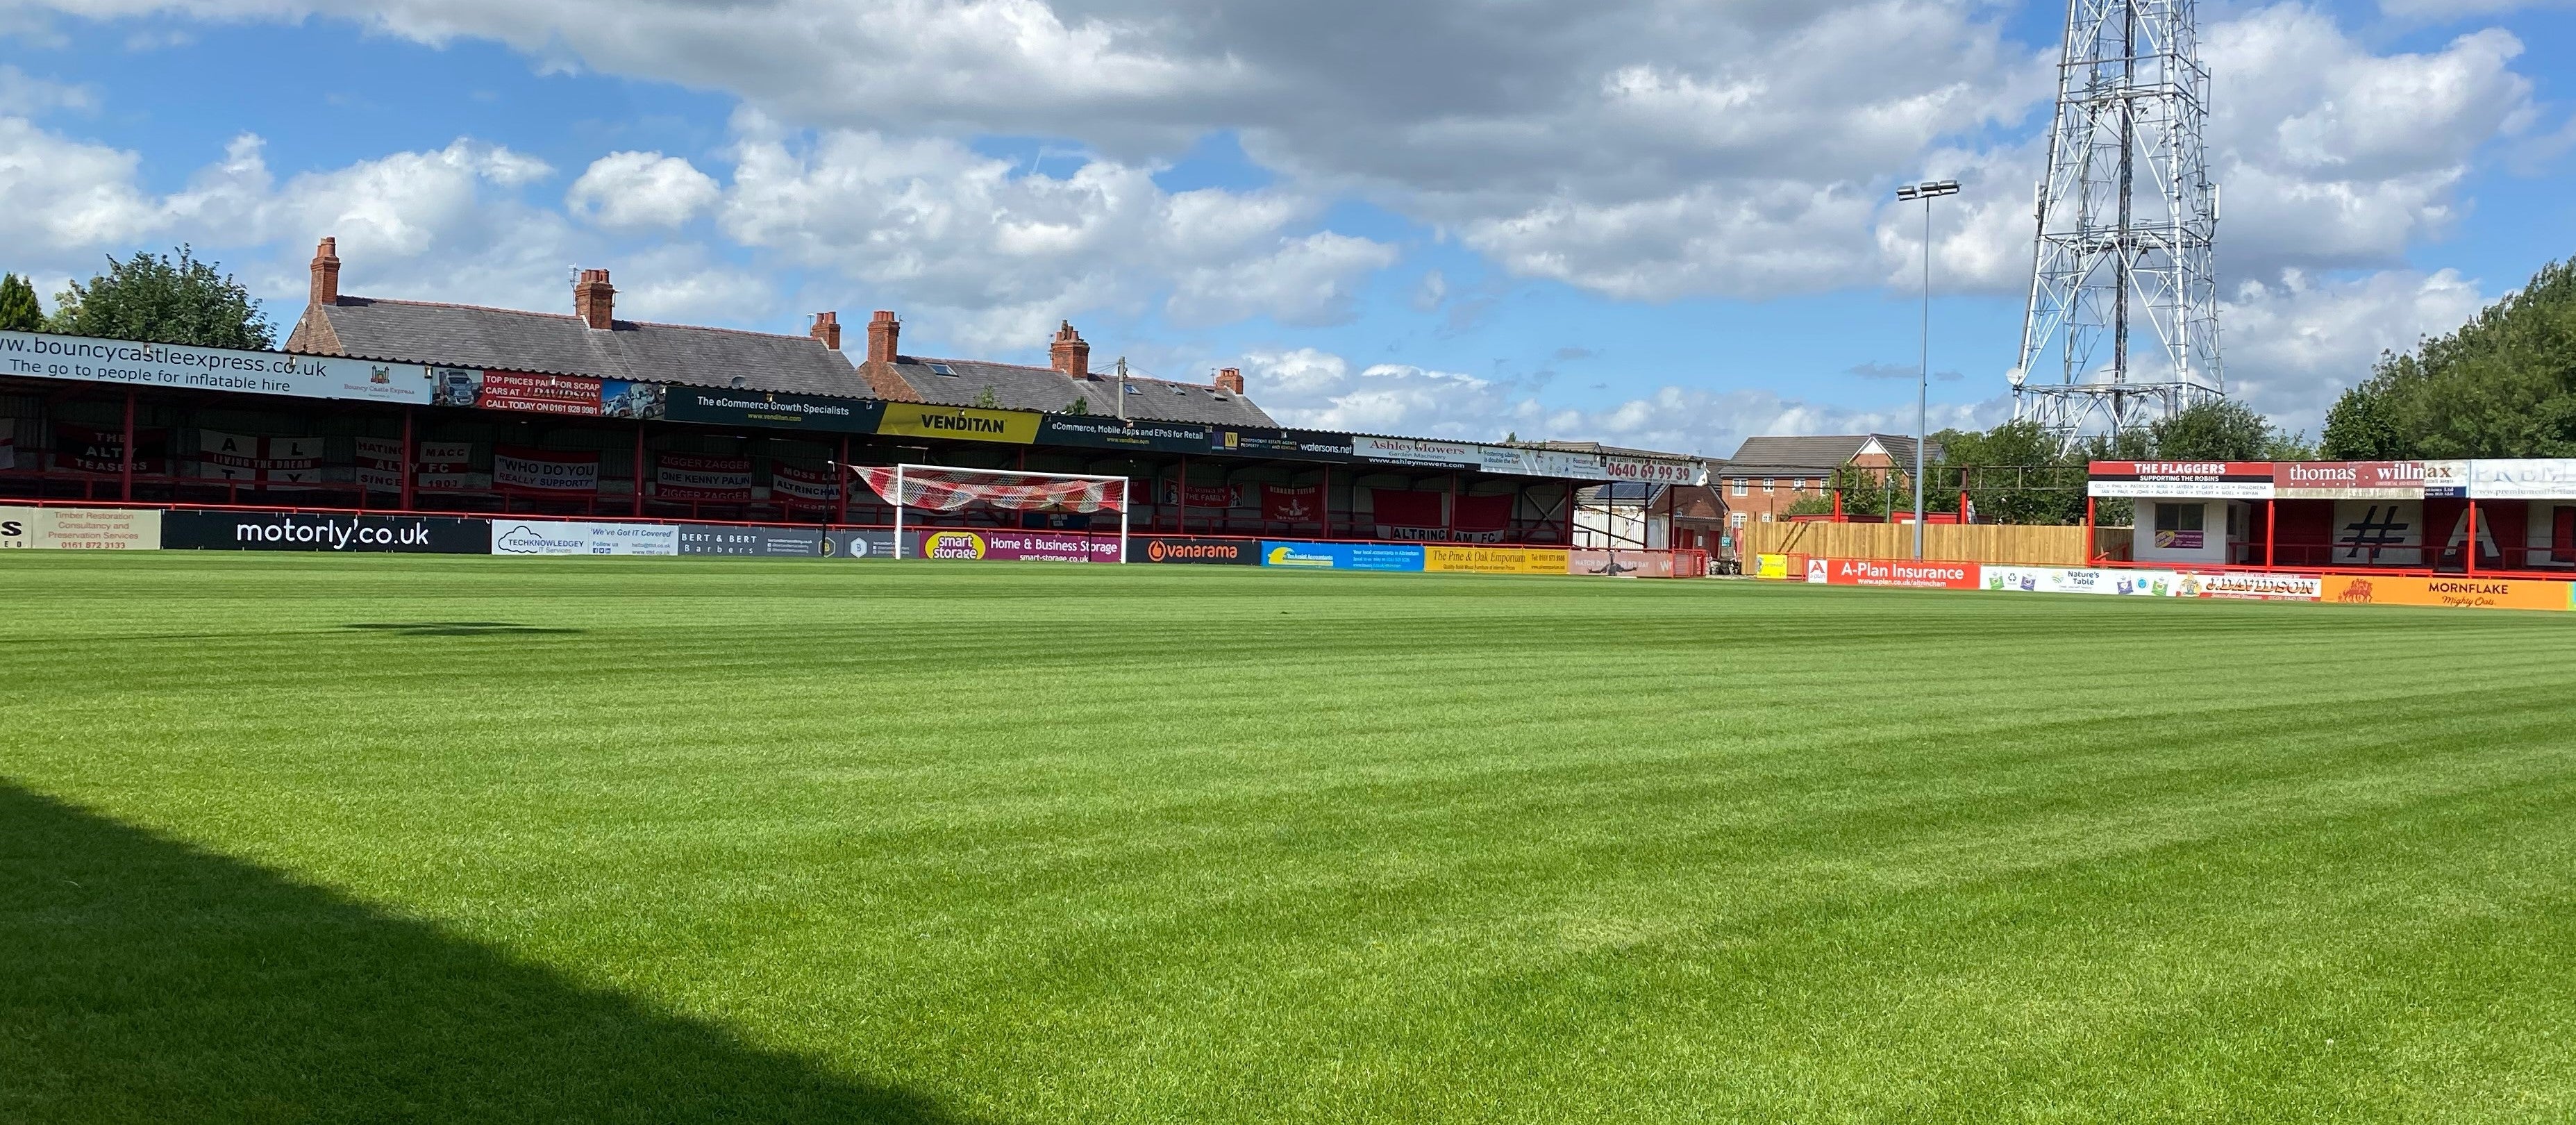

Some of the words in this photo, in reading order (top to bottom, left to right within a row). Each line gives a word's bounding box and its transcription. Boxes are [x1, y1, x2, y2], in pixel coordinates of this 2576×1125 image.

[0, 336, 327, 377] w.bouncycastleexpress.co.uk
[9, 359, 41, 372] The
[49, 364, 68, 376] go
[76, 363, 91, 376] to
[98, 367, 151, 382] people
[158, 370, 179, 383] for
[185, 372, 256, 389] inflatable
[262, 378, 290, 391] hire
[503, 377, 533, 385] PRICES
[344, 383, 368, 393] Bouncy
[486, 387, 508, 395] CARS
[486, 400, 507, 408] CALL
[508, 401, 535, 410] TODAY
[537, 403, 548, 411] ON
[697, 397, 714, 406] The
[716, 398, 769, 410] eCommerce
[770, 401, 801, 412] Growth
[803, 404, 849, 415] Specialists
[921, 414, 1005, 433] VENDITAN
[1052, 422, 1096, 434] eCommerce,
[1098, 424, 1120, 435] Mobile
[1121, 426, 1139, 437] Apps
[1140, 428, 1153, 437] and
[1154, 428, 1172, 437] EPoS
[1173, 429, 1183, 438] for
[1185, 430, 1203, 440] Retail
[1300, 442, 1352, 454] watersons.net
[1369, 440, 1413, 453] Ashley
[1415, 442, 1464, 455] Mowers
[213, 454, 249, 468] LIVING
[254, 459, 272, 469] THE
[277, 459, 312, 469] DREAM
[662, 456, 701, 467] ZIGGER
[705, 460, 750, 469] ZAGGER
[1369, 457, 1464, 469] www.ashleymowers.com
[429, 462, 449, 474] FC
[543, 464, 562, 476] DO
[568, 465, 594, 476] YOU
[784, 467, 815, 480] MOSS
[1608, 462, 1637, 476] 0640
[1641, 465, 1655, 478] 69
[1658, 466, 1673, 479] 99
[1676, 467, 1690, 480] 39
[2134, 463, 2159, 474] THE
[2161, 463, 2226, 474] FLAGGERS
[2290, 464, 2357, 481] thomas
[499, 472, 536, 485] REALLY
[662, 472, 681, 482] ONE
[685, 474, 720, 484] KENNY
[58, 522, 110, 532] Consultancy
[681, 533, 710, 542] BERT
[729, 535, 758, 544] BERT
[1394, 528, 1472, 542] ALTRINCAM
[1481, 533, 1495, 542] FC
[508, 539, 584, 547] TECHKNOWLEDGEY
[939, 536, 973, 547] smart
[991, 538, 1020, 549] Home
[1024, 539, 1032, 549] &
[1036, 540, 1077, 551] Business
[1080, 541, 1117, 554] Storage
[685, 544, 753, 553] Barbers
[934, 548, 977, 559] storage
[1167, 545, 1237, 558] vanarama
[1020, 554, 1088, 562] smart-storage.co.uk
[1433, 550, 1446, 560] The
[1448, 551, 1464, 561] Pine
[1465, 551, 1472, 561] &
[1474, 551, 1488, 562] Oak
[1491, 552, 1525, 565] Emporium
[1841, 562, 1888, 576] A-Plan
[1893, 563, 1964, 580] Insurance
[1857, 578, 1946, 588] www.aplan.co.uk/altrincham
[2206, 577, 2318, 595] J.DAVIDSON
[2428, 582, 2509, 594] MORNFLAKE
[2442, 595, 2473, 608] Mighty
